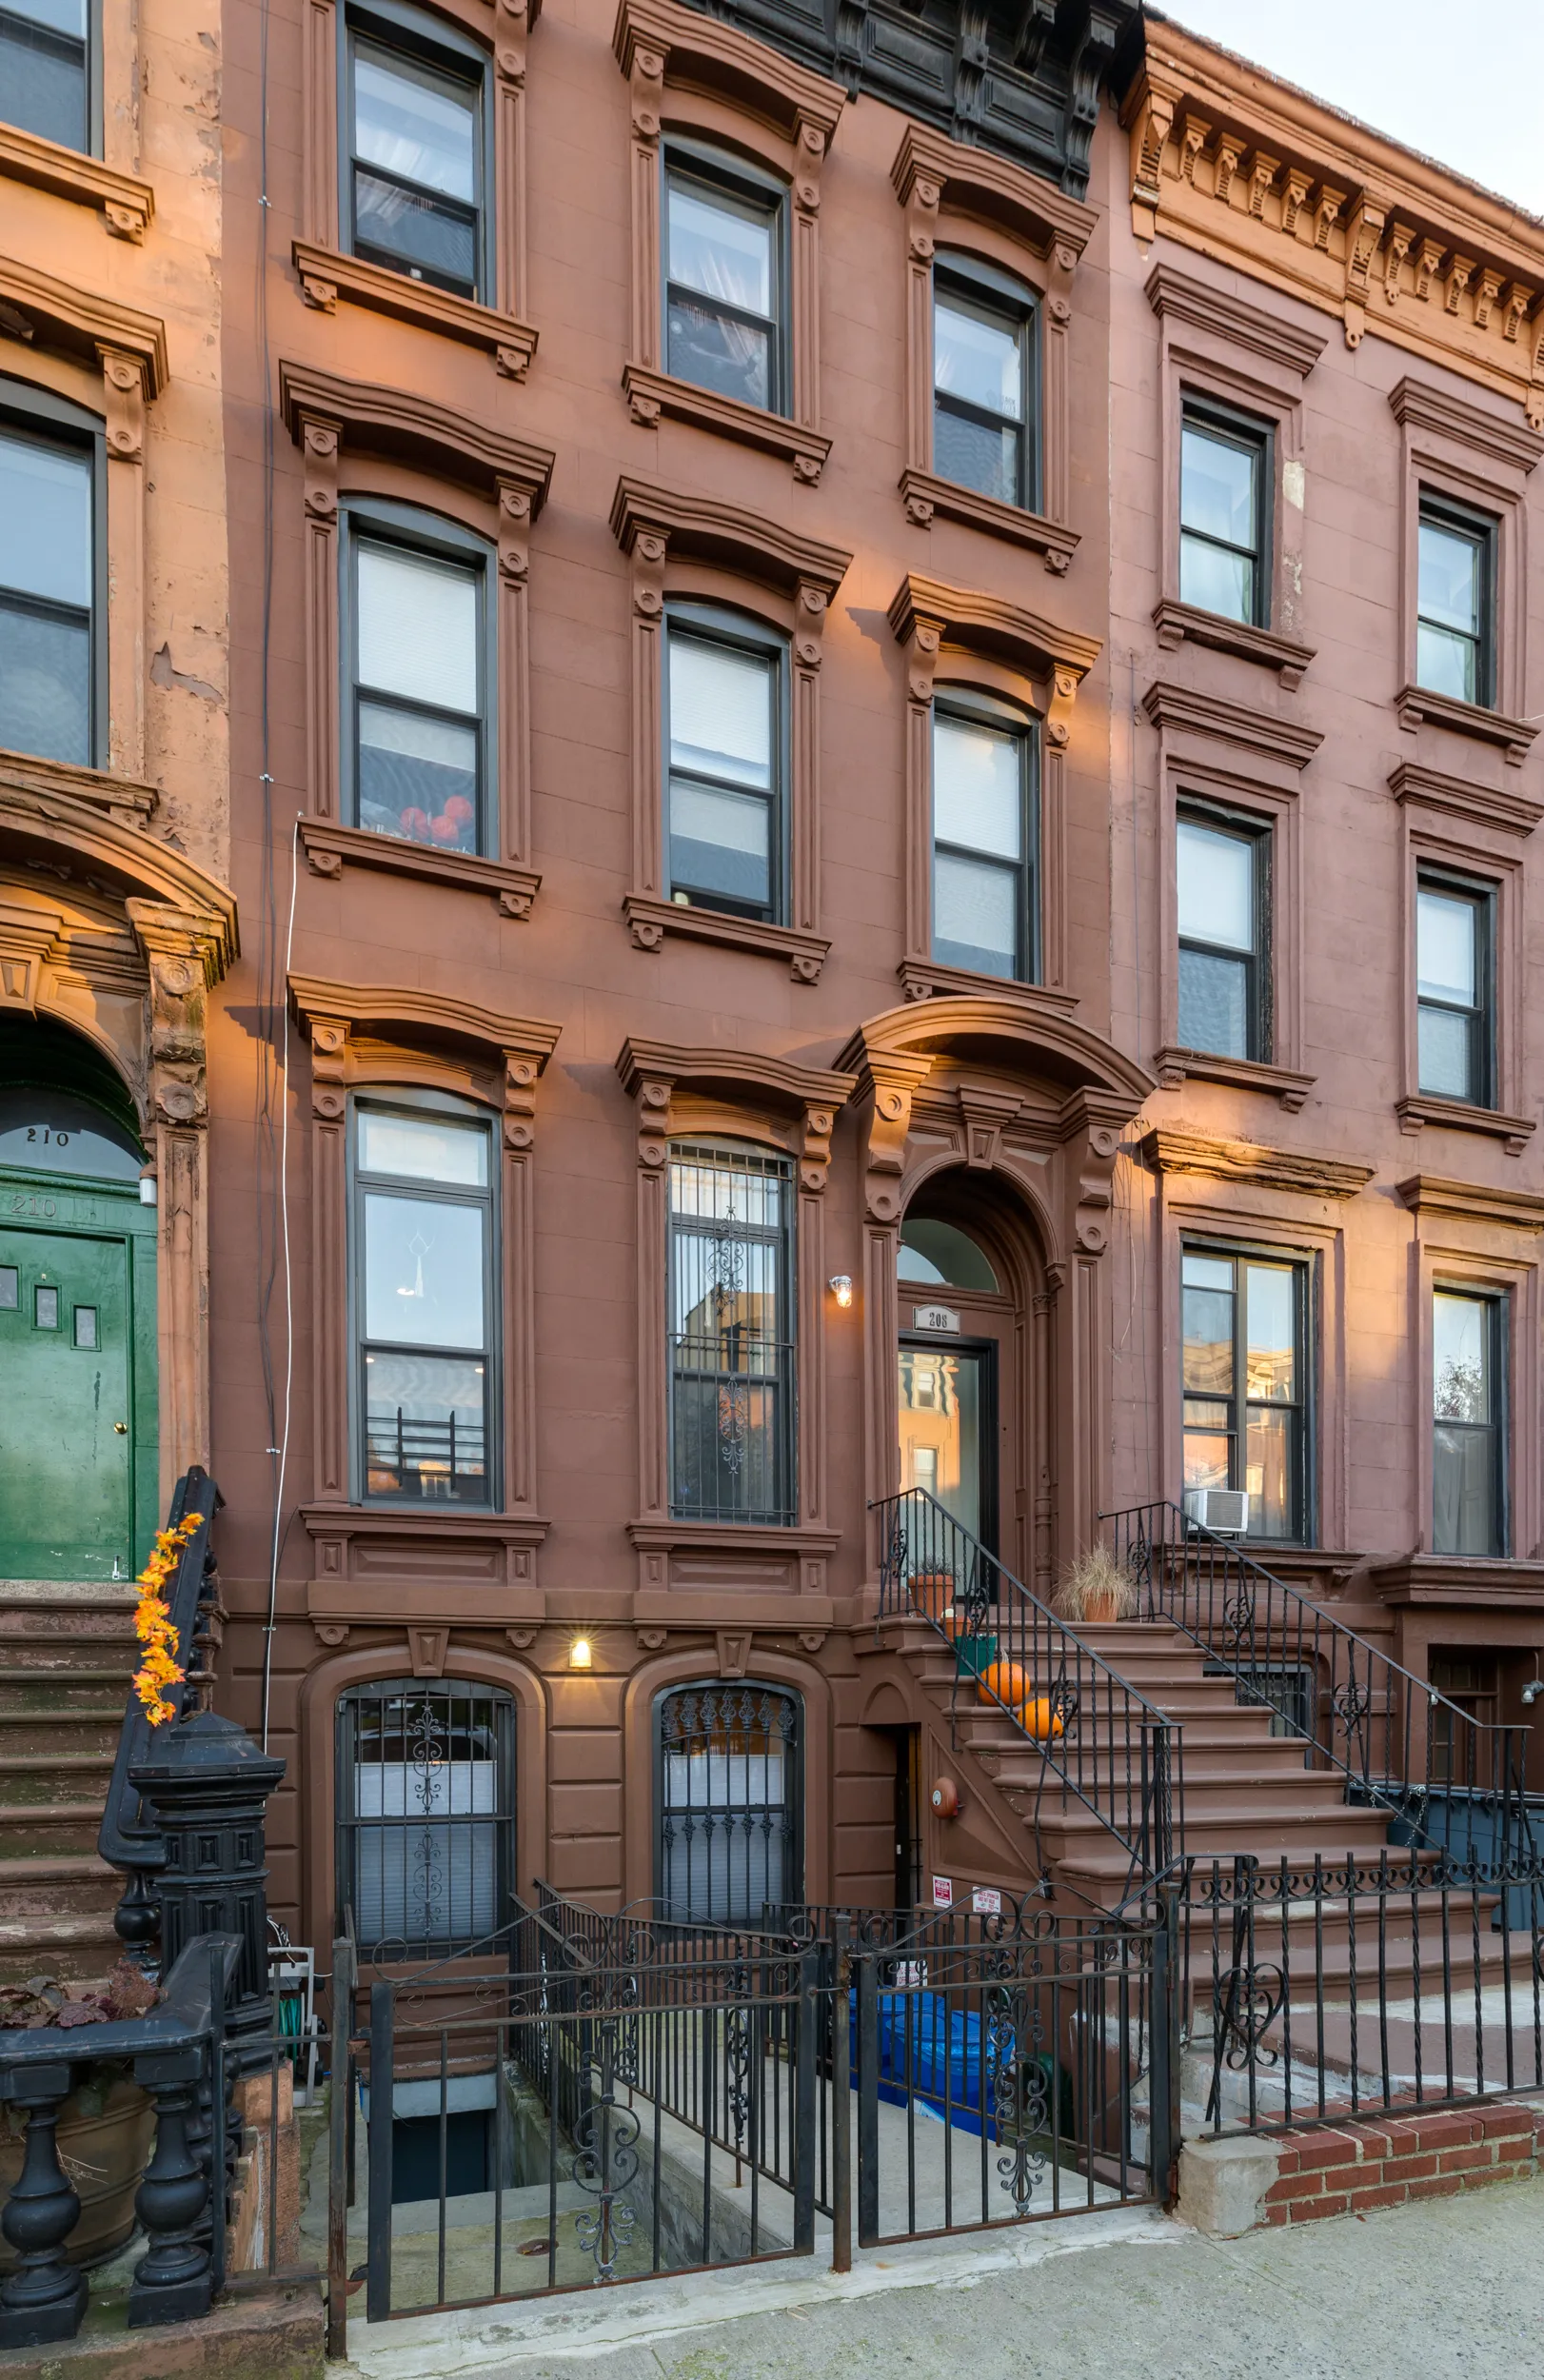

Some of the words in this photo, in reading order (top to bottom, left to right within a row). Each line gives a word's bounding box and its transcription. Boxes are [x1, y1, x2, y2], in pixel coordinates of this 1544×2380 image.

[27, 1128, 69, 1146] 210
[11, 1196, 56, 1217] 210
[929, 1312, 947, 1328] 208
